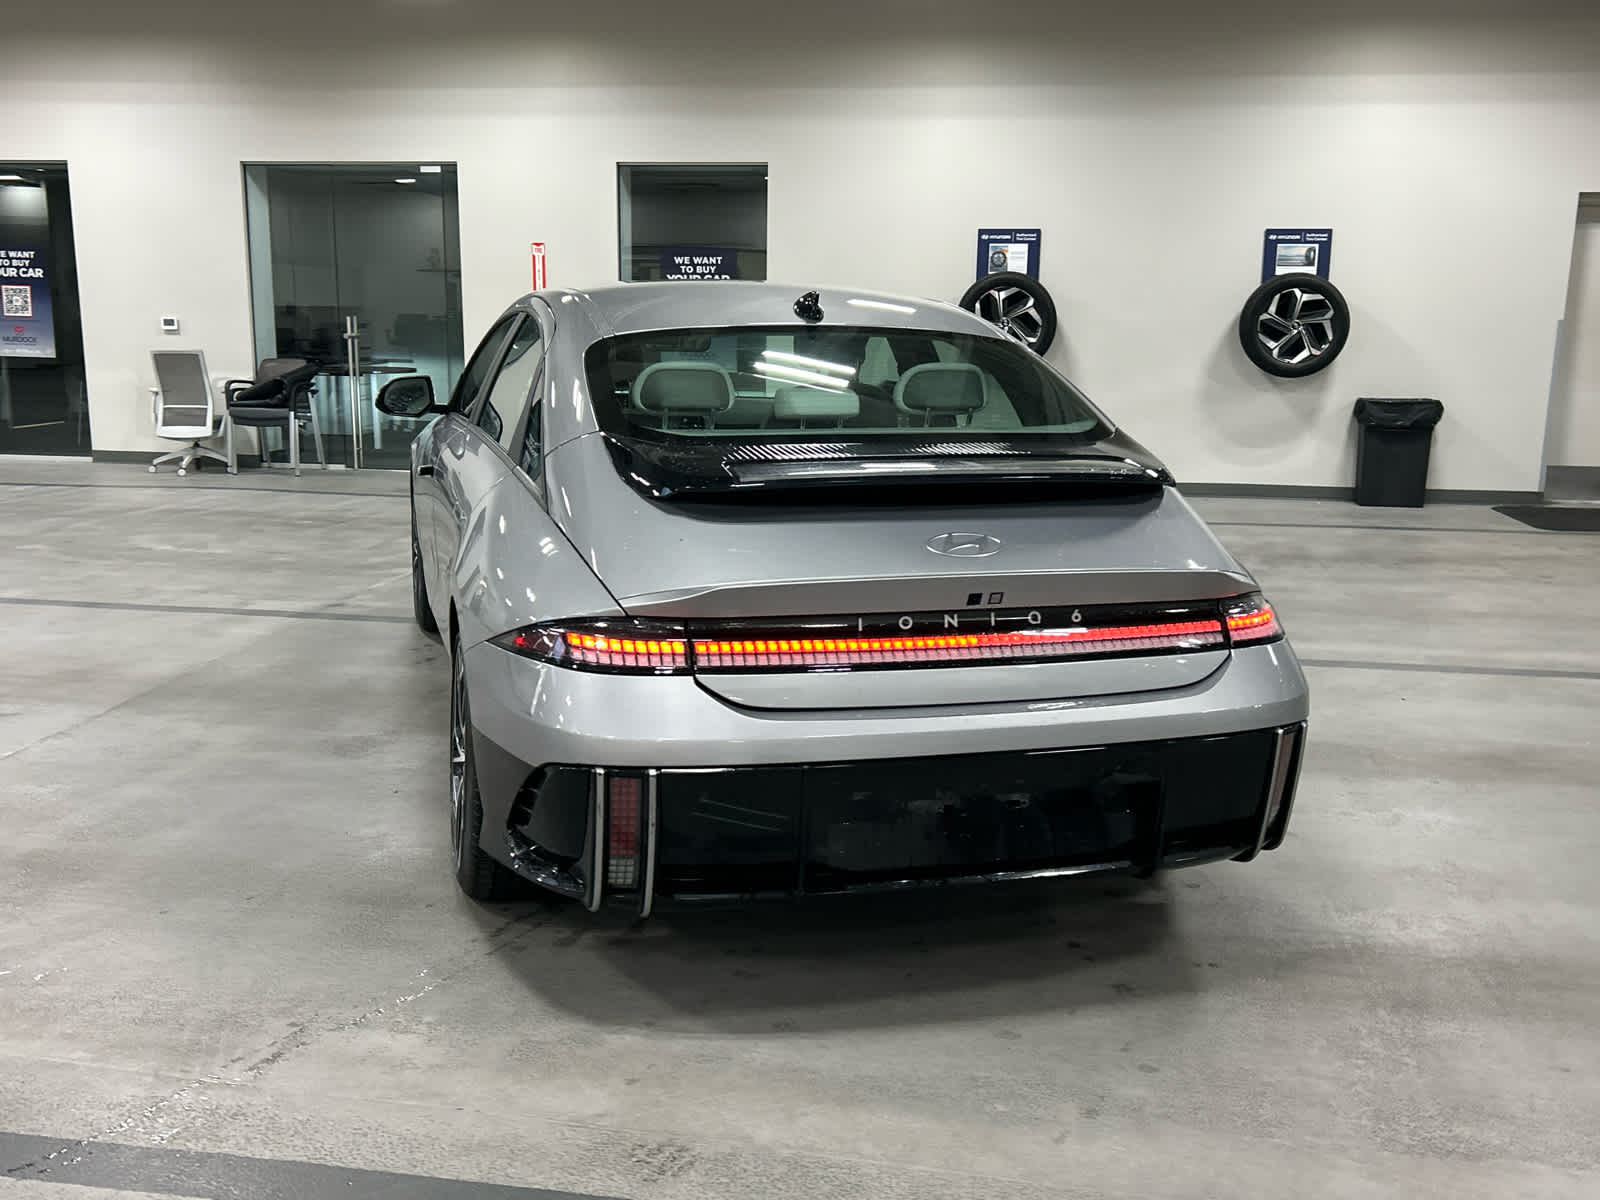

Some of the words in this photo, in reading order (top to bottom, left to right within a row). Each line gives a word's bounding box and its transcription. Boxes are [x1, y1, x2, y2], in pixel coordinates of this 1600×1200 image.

[0, 250, 7, 258] E
[8, 251, 35, 259] WANT
[673, 256, 690, 264] WE
[692, 256, 723, 264] WANT
[19, 267, 44, 278] CAR
[680, 265, 694, 273] TO
[696, 265, 716, 273] BUY
[857, 610, 1042, 632] IONIQ
[1071, 609, 1082, 623] 6
